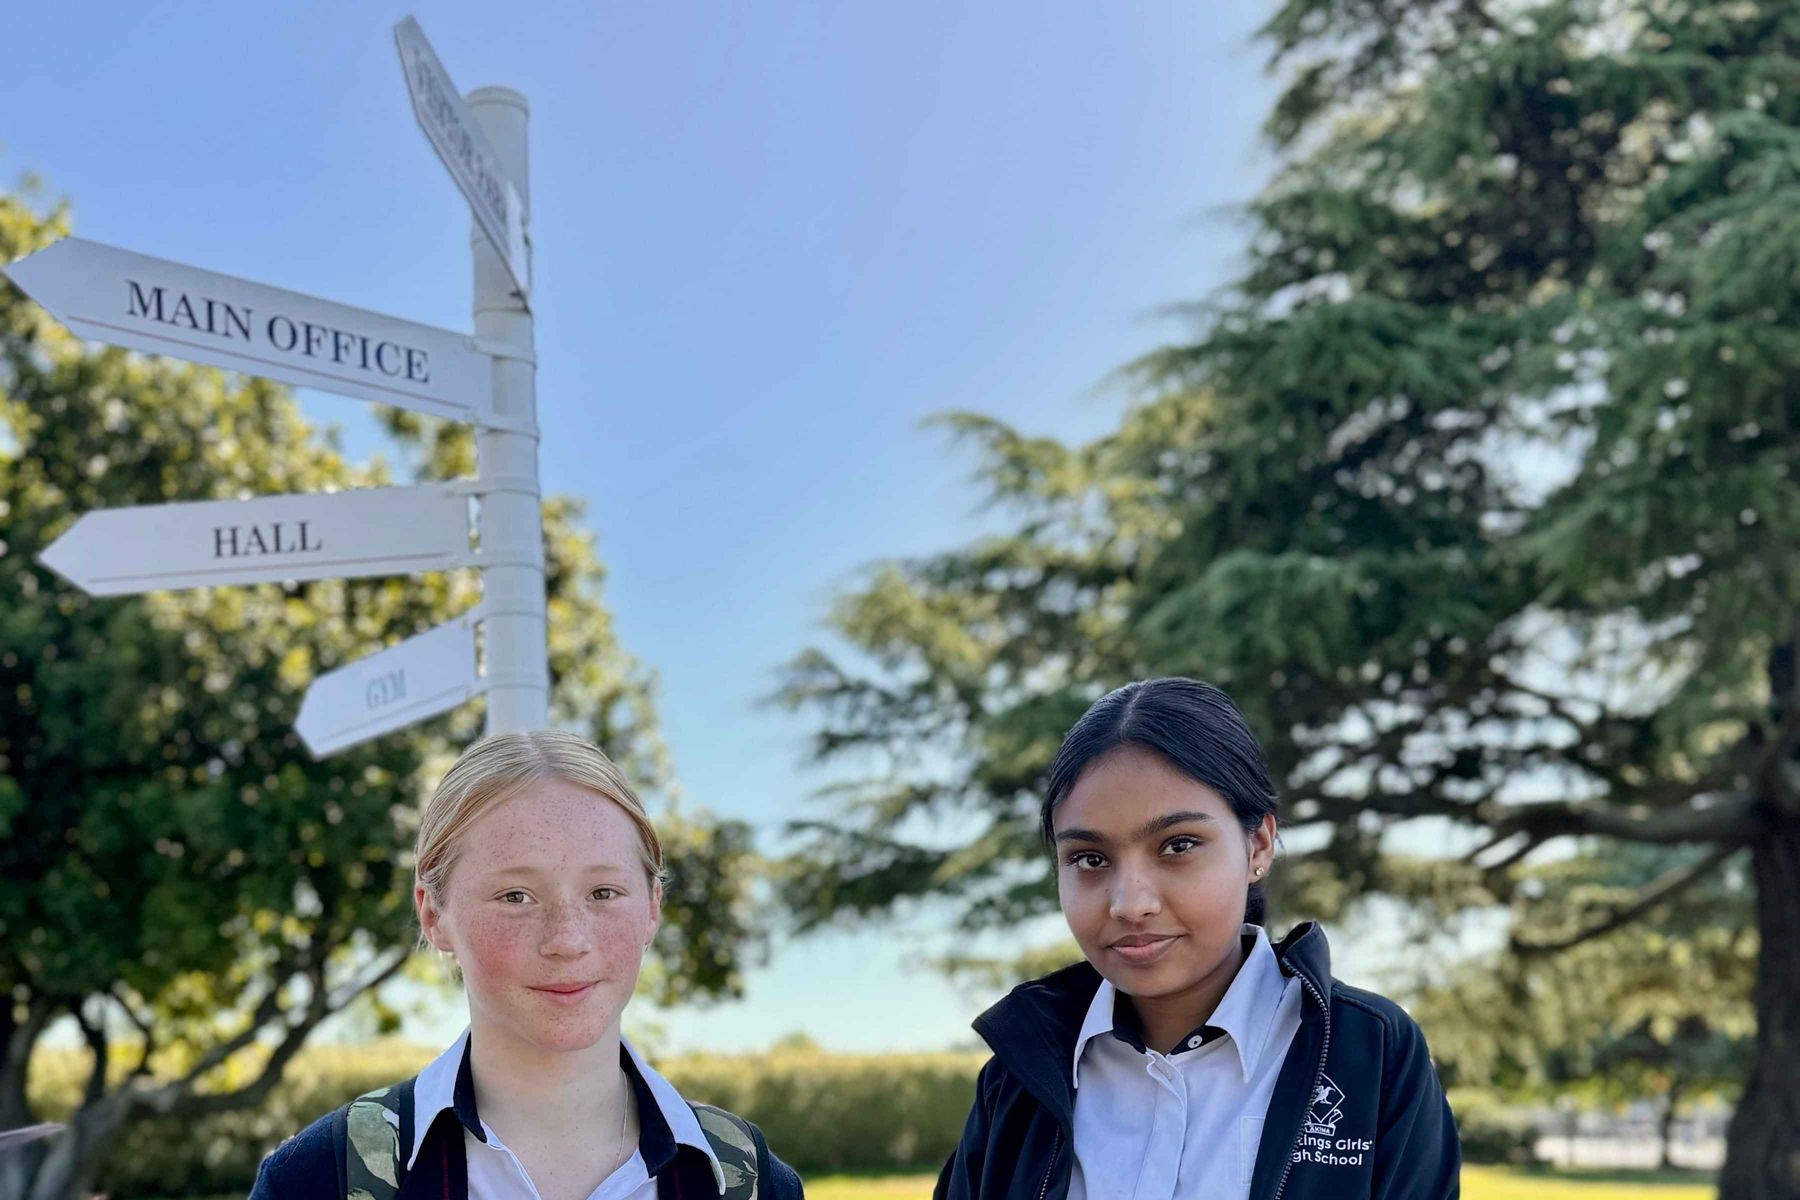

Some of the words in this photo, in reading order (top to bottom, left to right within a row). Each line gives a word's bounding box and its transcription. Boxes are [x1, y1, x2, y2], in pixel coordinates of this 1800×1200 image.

[126, 280, 253, 341] MAIN
[267, 316, 430, 384] OFFICE
[213, 521, 322, 558] HALL
[1298, 1134, 1332, 1150] ings
[1335, 1138, 1373, 1151] Girls'
[1314, 1150, 1363, 1166] School
